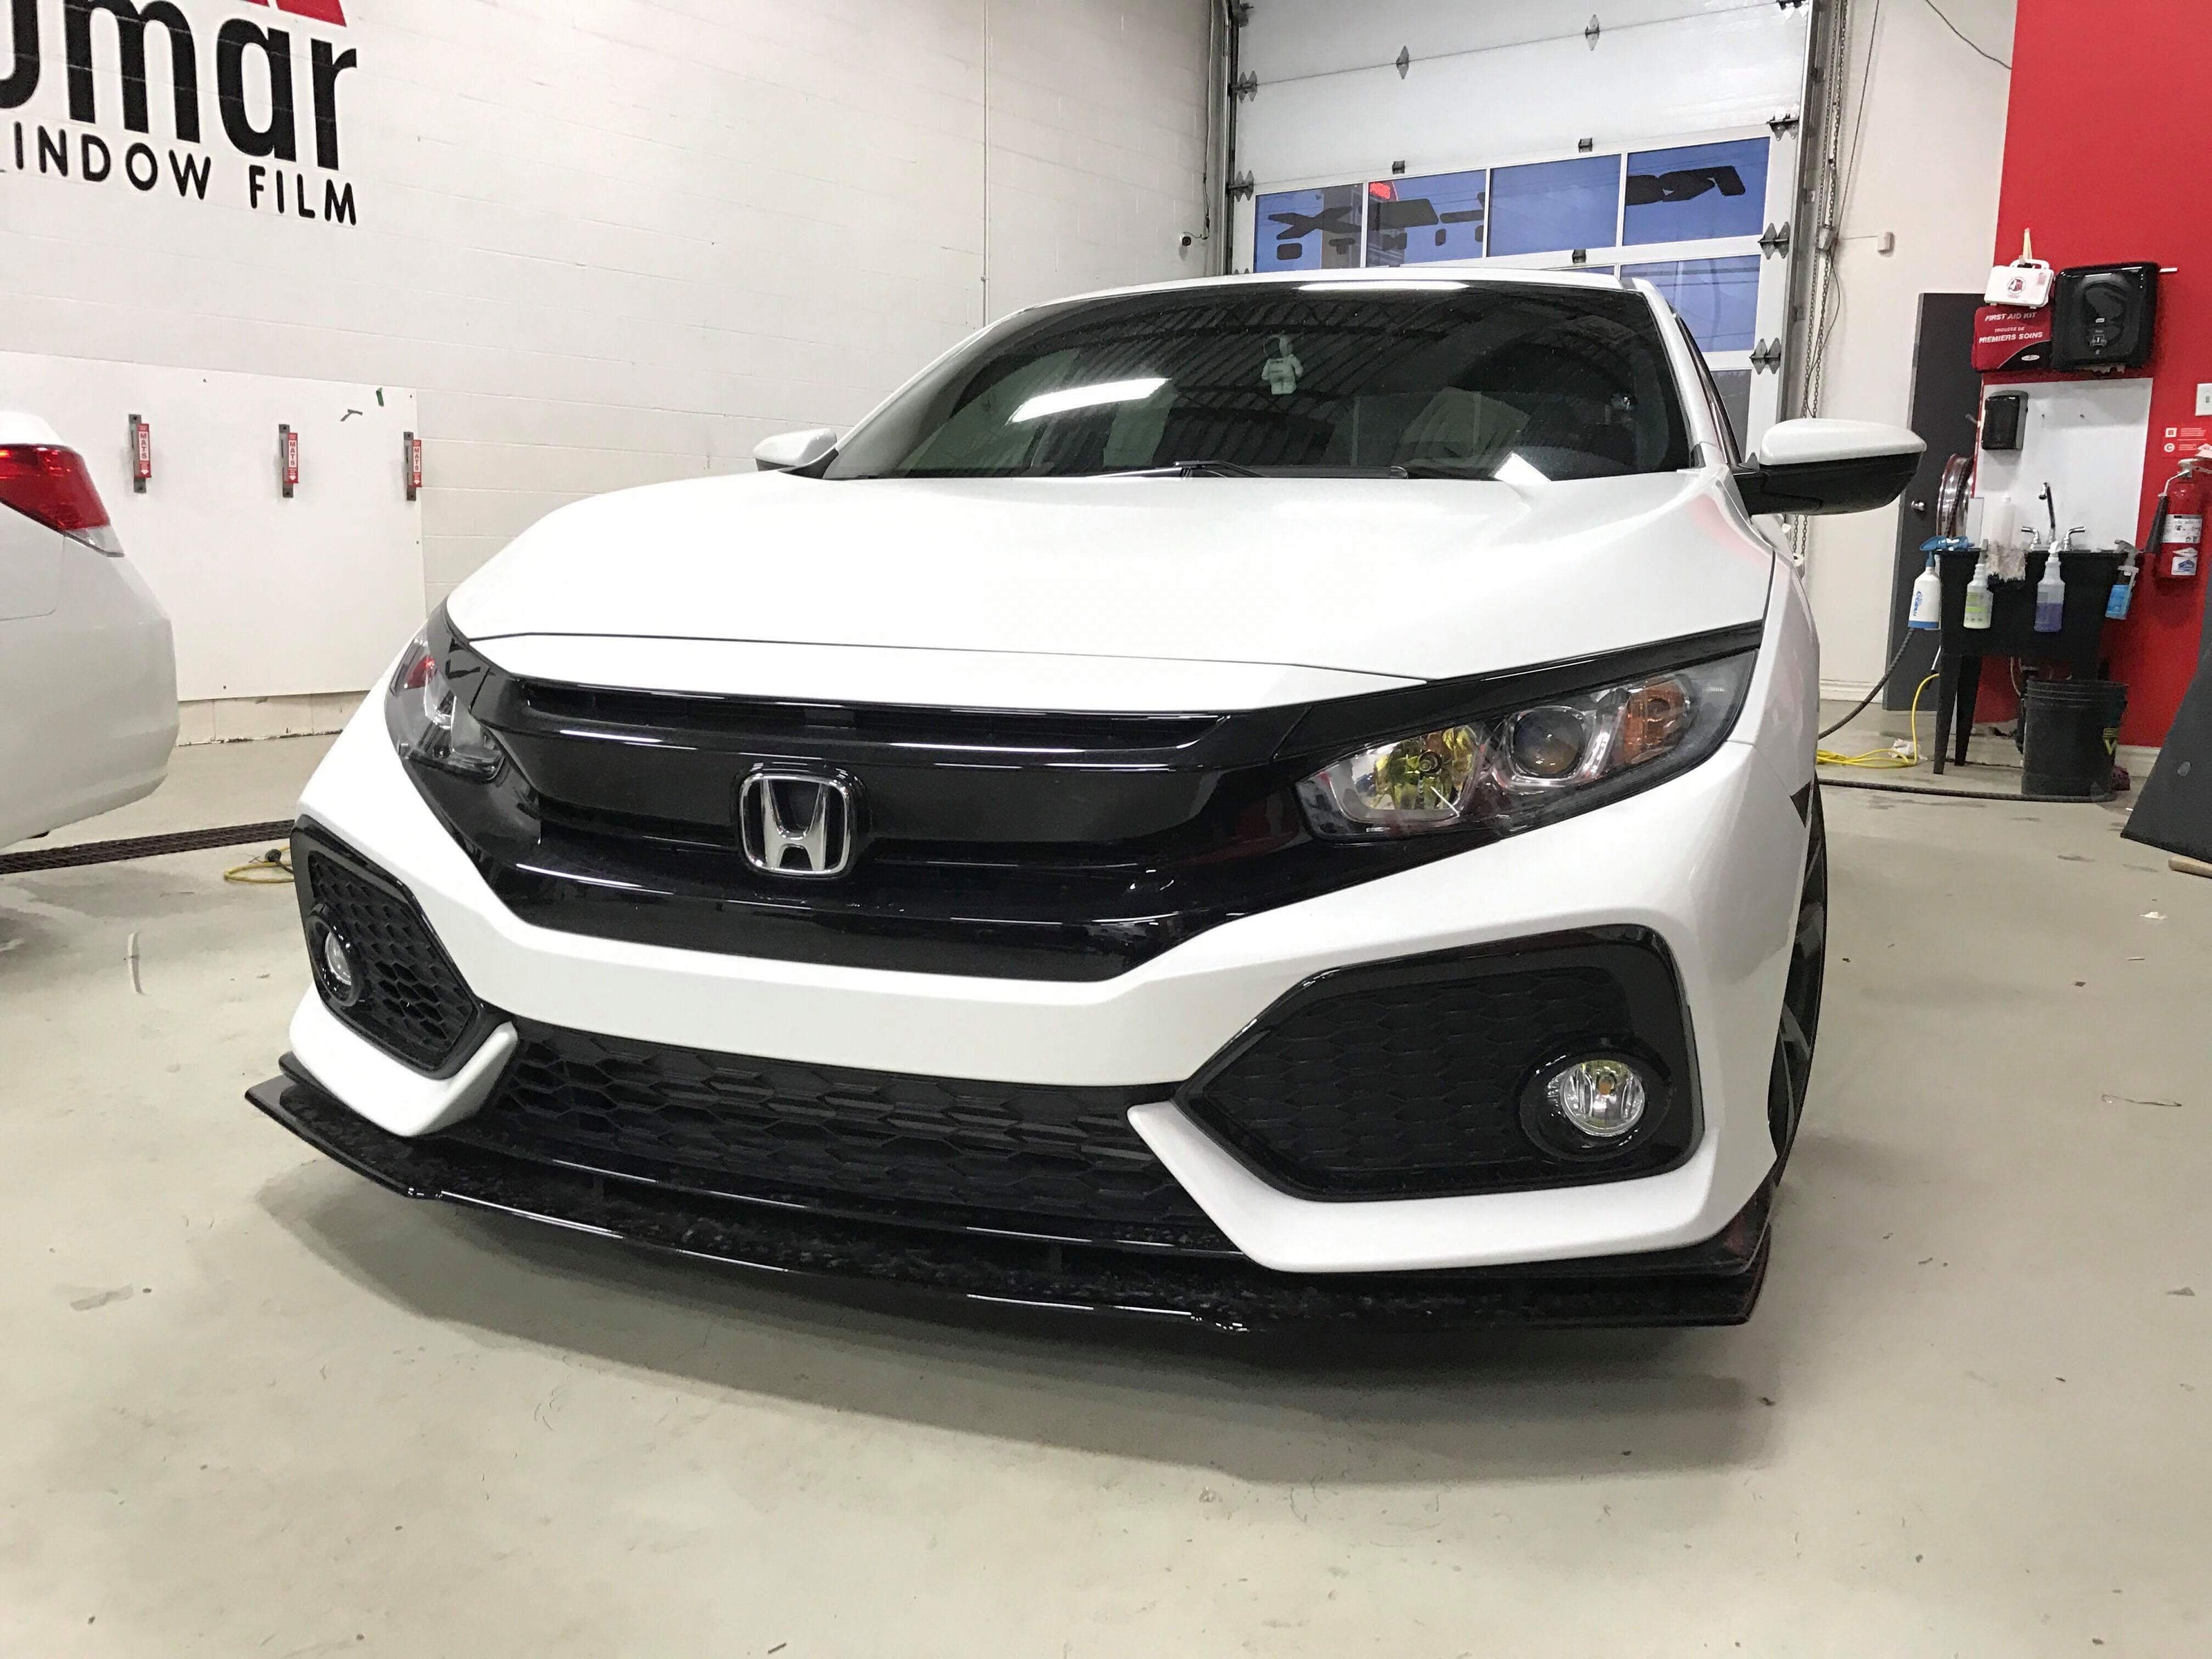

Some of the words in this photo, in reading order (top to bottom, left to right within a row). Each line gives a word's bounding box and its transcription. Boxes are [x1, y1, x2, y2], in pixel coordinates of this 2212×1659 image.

[249, 165, 357, 226] FILM
[1985, 313, 2007, 321] FIRST
[1978, 334, 2016, 344] PREMIERS
